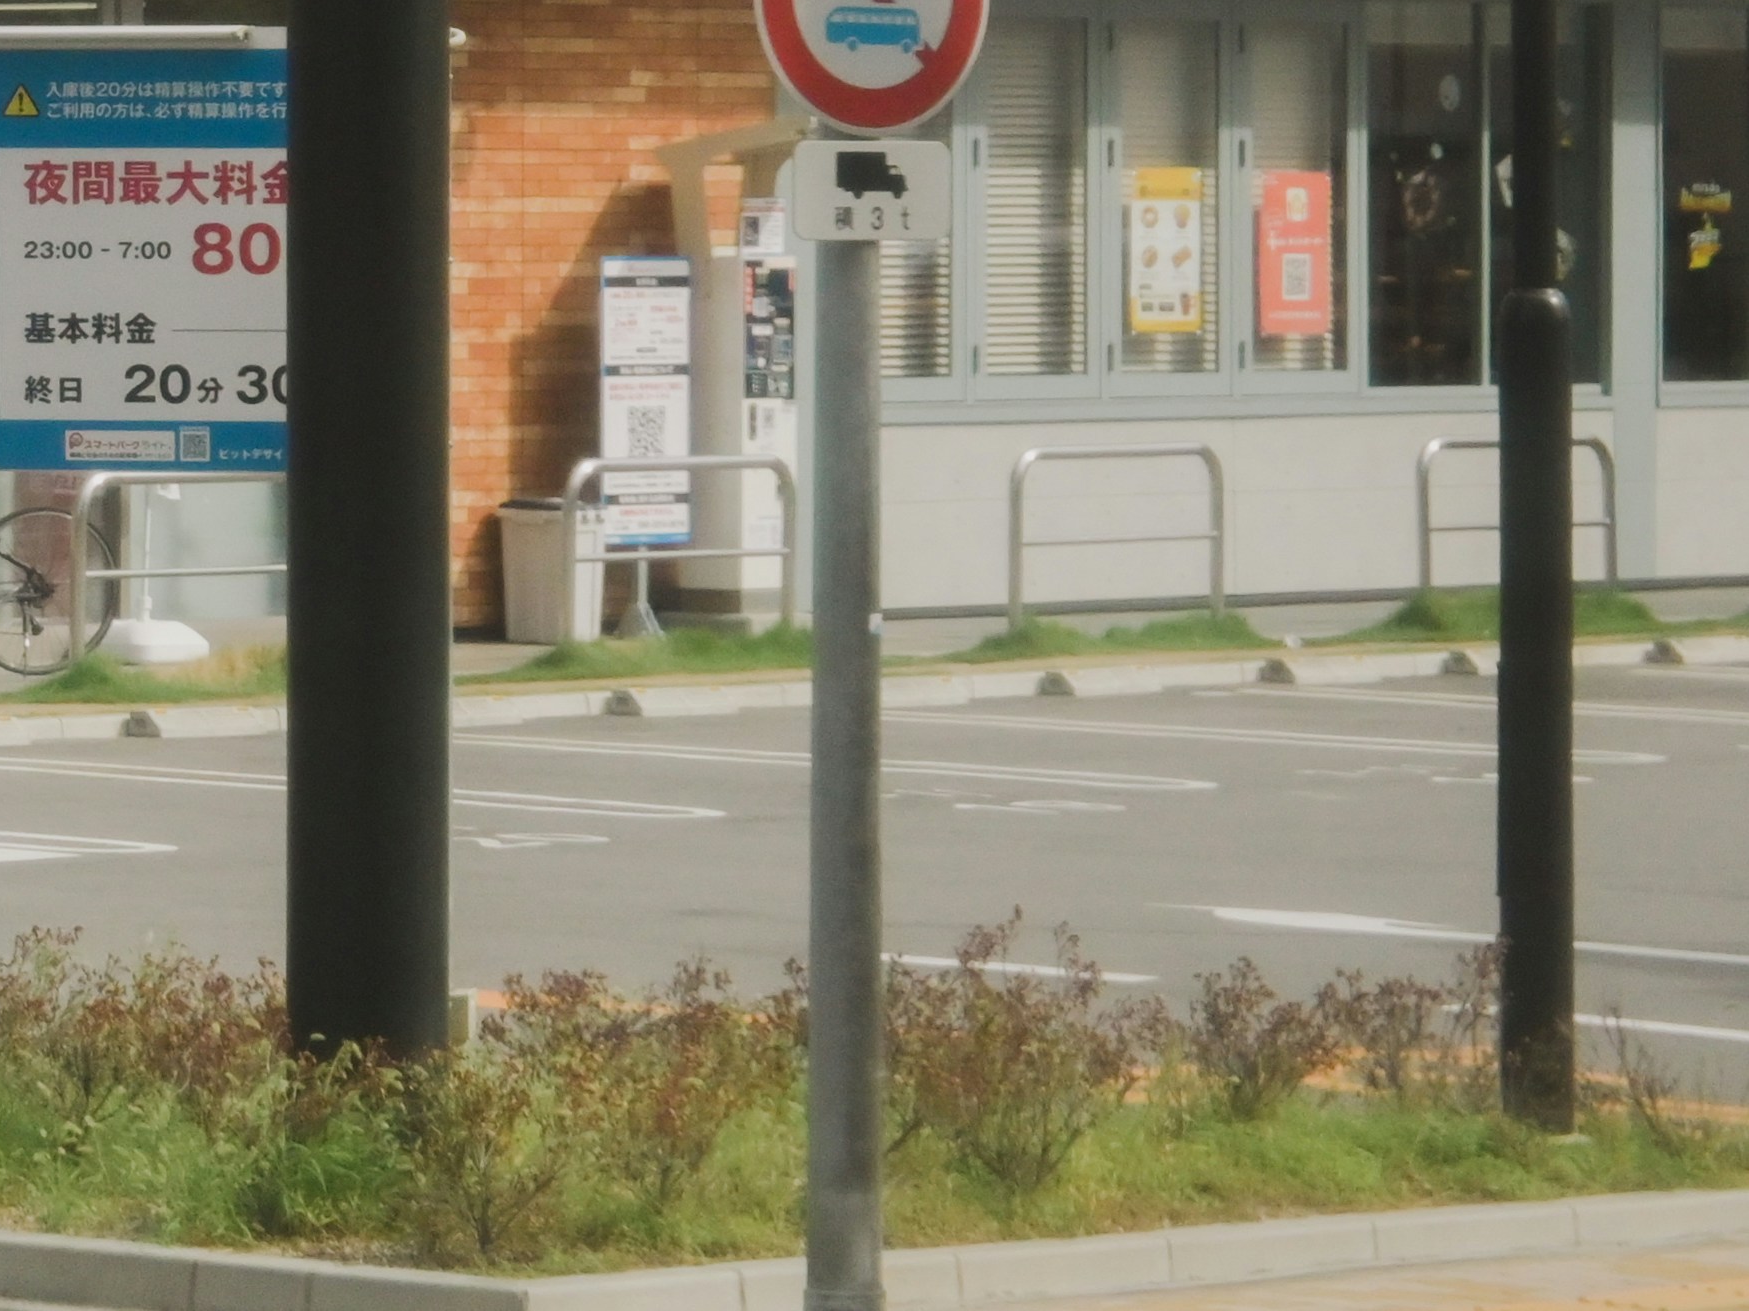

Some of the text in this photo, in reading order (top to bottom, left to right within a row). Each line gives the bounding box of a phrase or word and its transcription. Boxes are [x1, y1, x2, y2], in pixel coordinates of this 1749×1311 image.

[23, 160, 288, 205] 夜間最大料金
[23, 240, 92, 260] 23:00
[118, 240, 172, 260] 7:00
[24, 312, 156, 344] 基本料金
[24, 376, 82, 404] 終日
[124, 364, 223, 404] 20分
